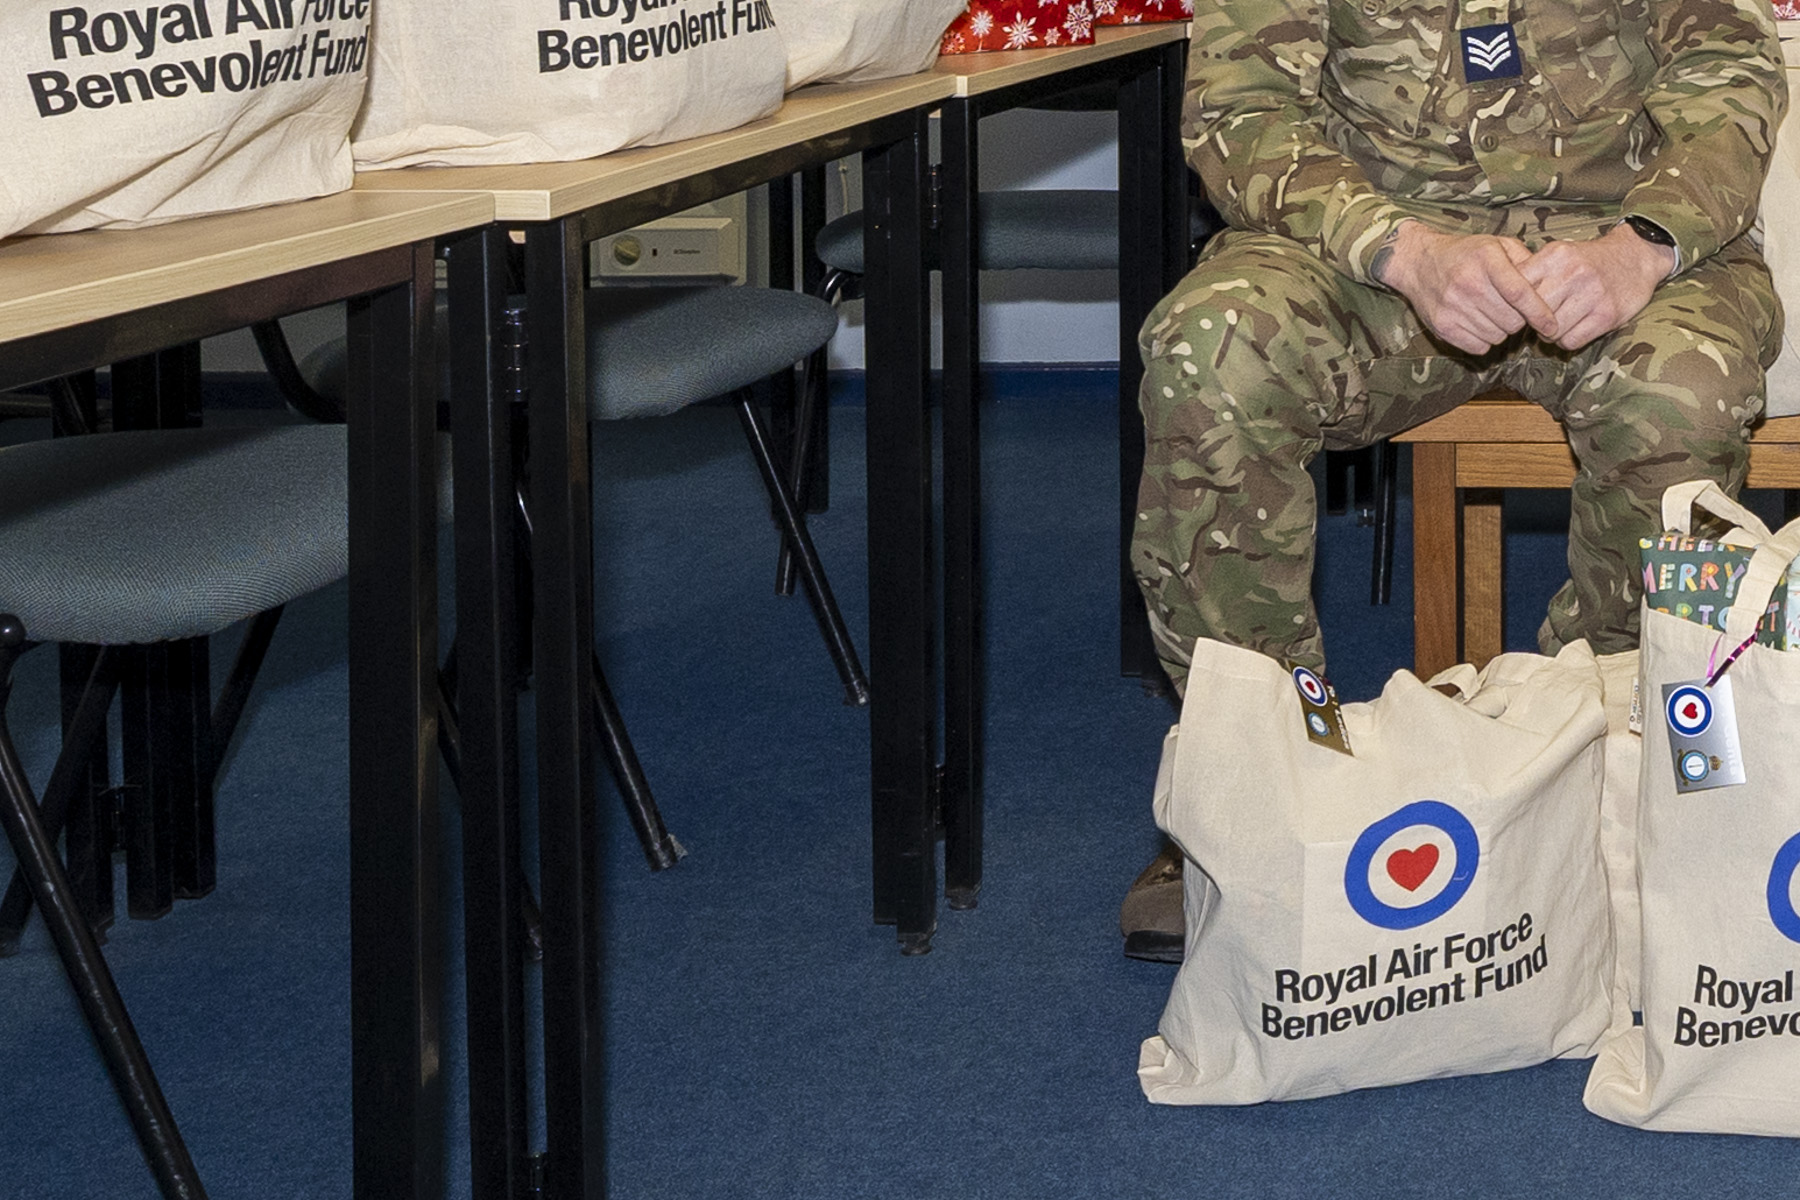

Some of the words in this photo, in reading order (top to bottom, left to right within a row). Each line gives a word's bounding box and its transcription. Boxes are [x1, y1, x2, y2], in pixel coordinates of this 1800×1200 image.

[27, 33, 308, 119] Benevolent
[307, 25, 371, 79] Fund
[537, 0, 728, 74] Benevolent
[1641, 561, 1746, 599] MERRY
[1261, 972, 1467, 1041] Benevolent
[1474, 933, 1549, 999] Fund
[1274, 954, 1378, 1006] Royal
[1384, 942, 1440, 984] Air
[1444, 912, 1534, 970] Force
[1693, 963, 1795, 1015] Royal
